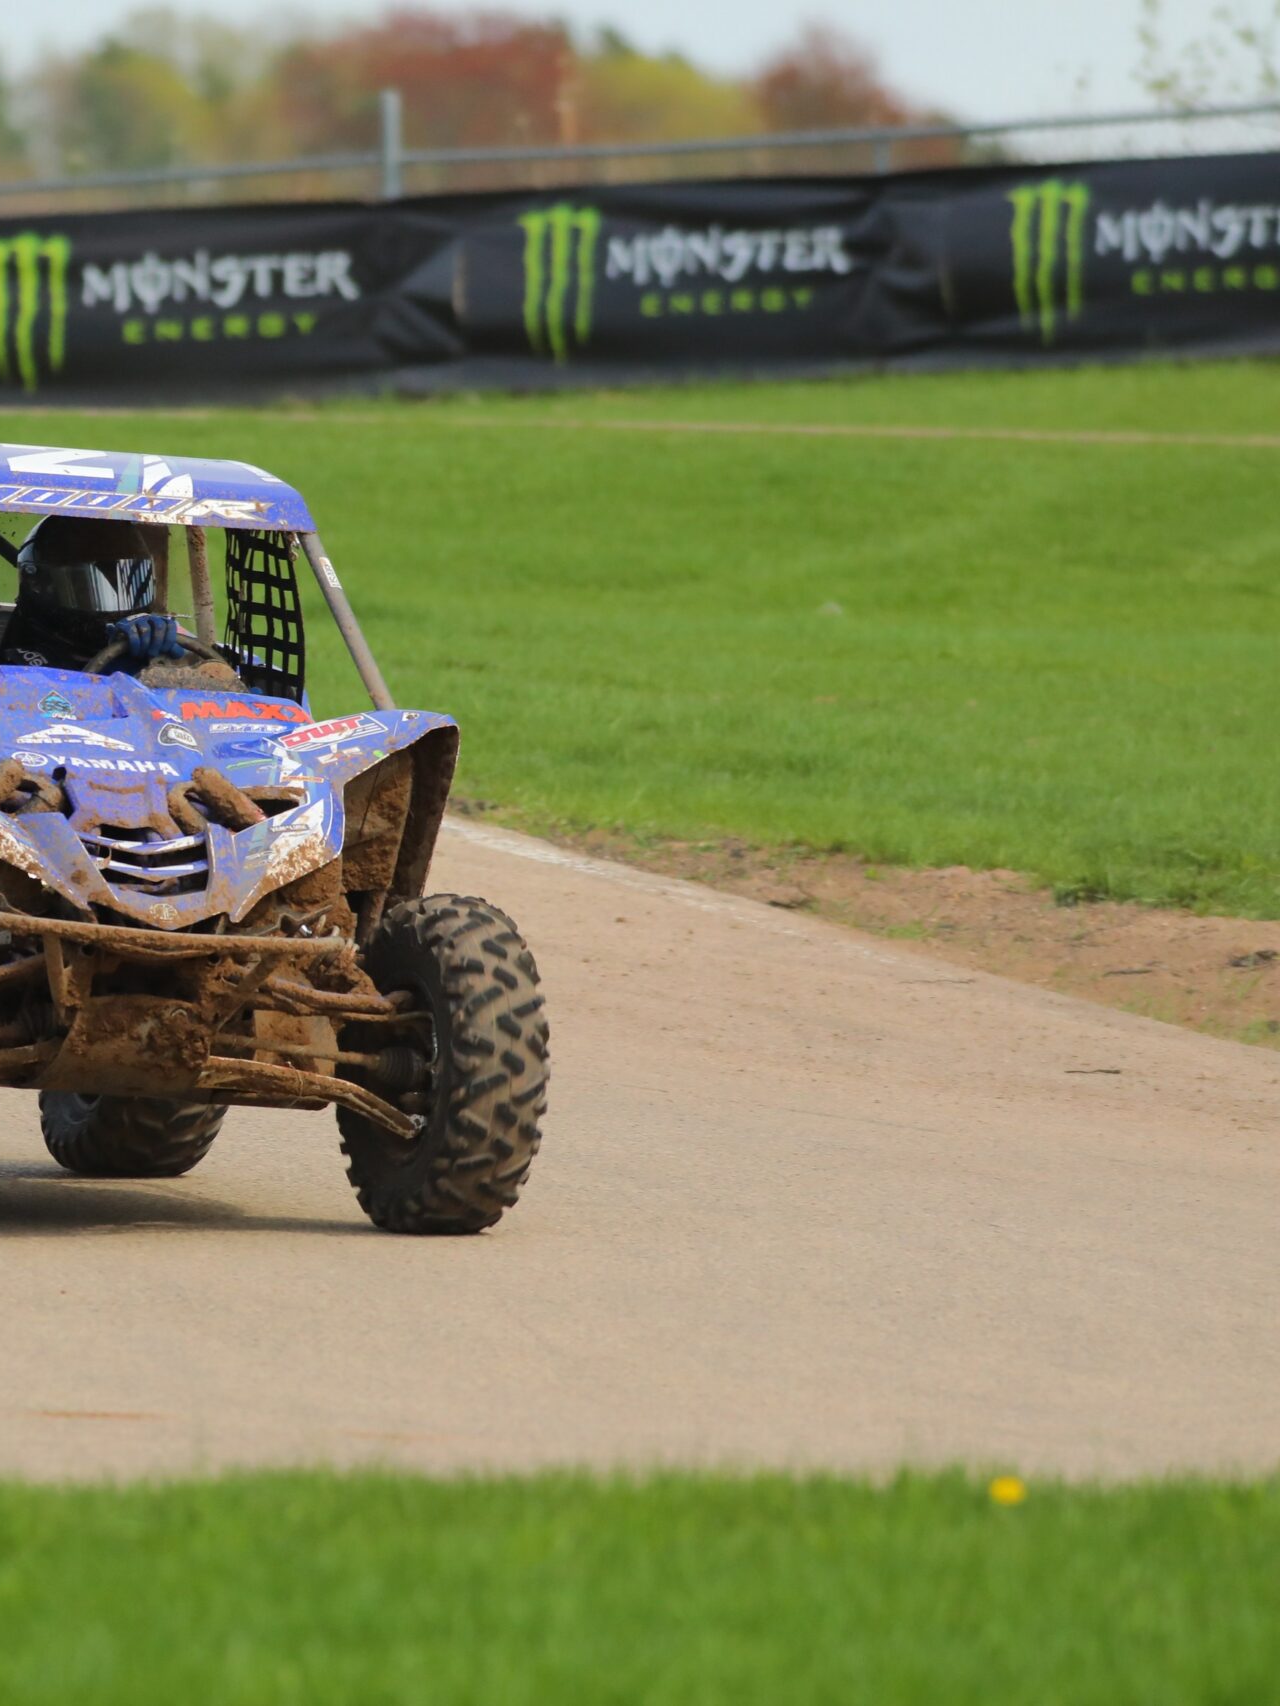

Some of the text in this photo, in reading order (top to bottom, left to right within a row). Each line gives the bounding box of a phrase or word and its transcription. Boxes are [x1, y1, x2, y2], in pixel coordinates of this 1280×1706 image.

[606, 224, 851, 287] MONSTER
[1095, 198, 1280, 264] MONST
[82, 247, 359, 314] MONSTER
[181, 701, 314, 724] MAXX
[48, 753, 180, 777] YAMAHA
